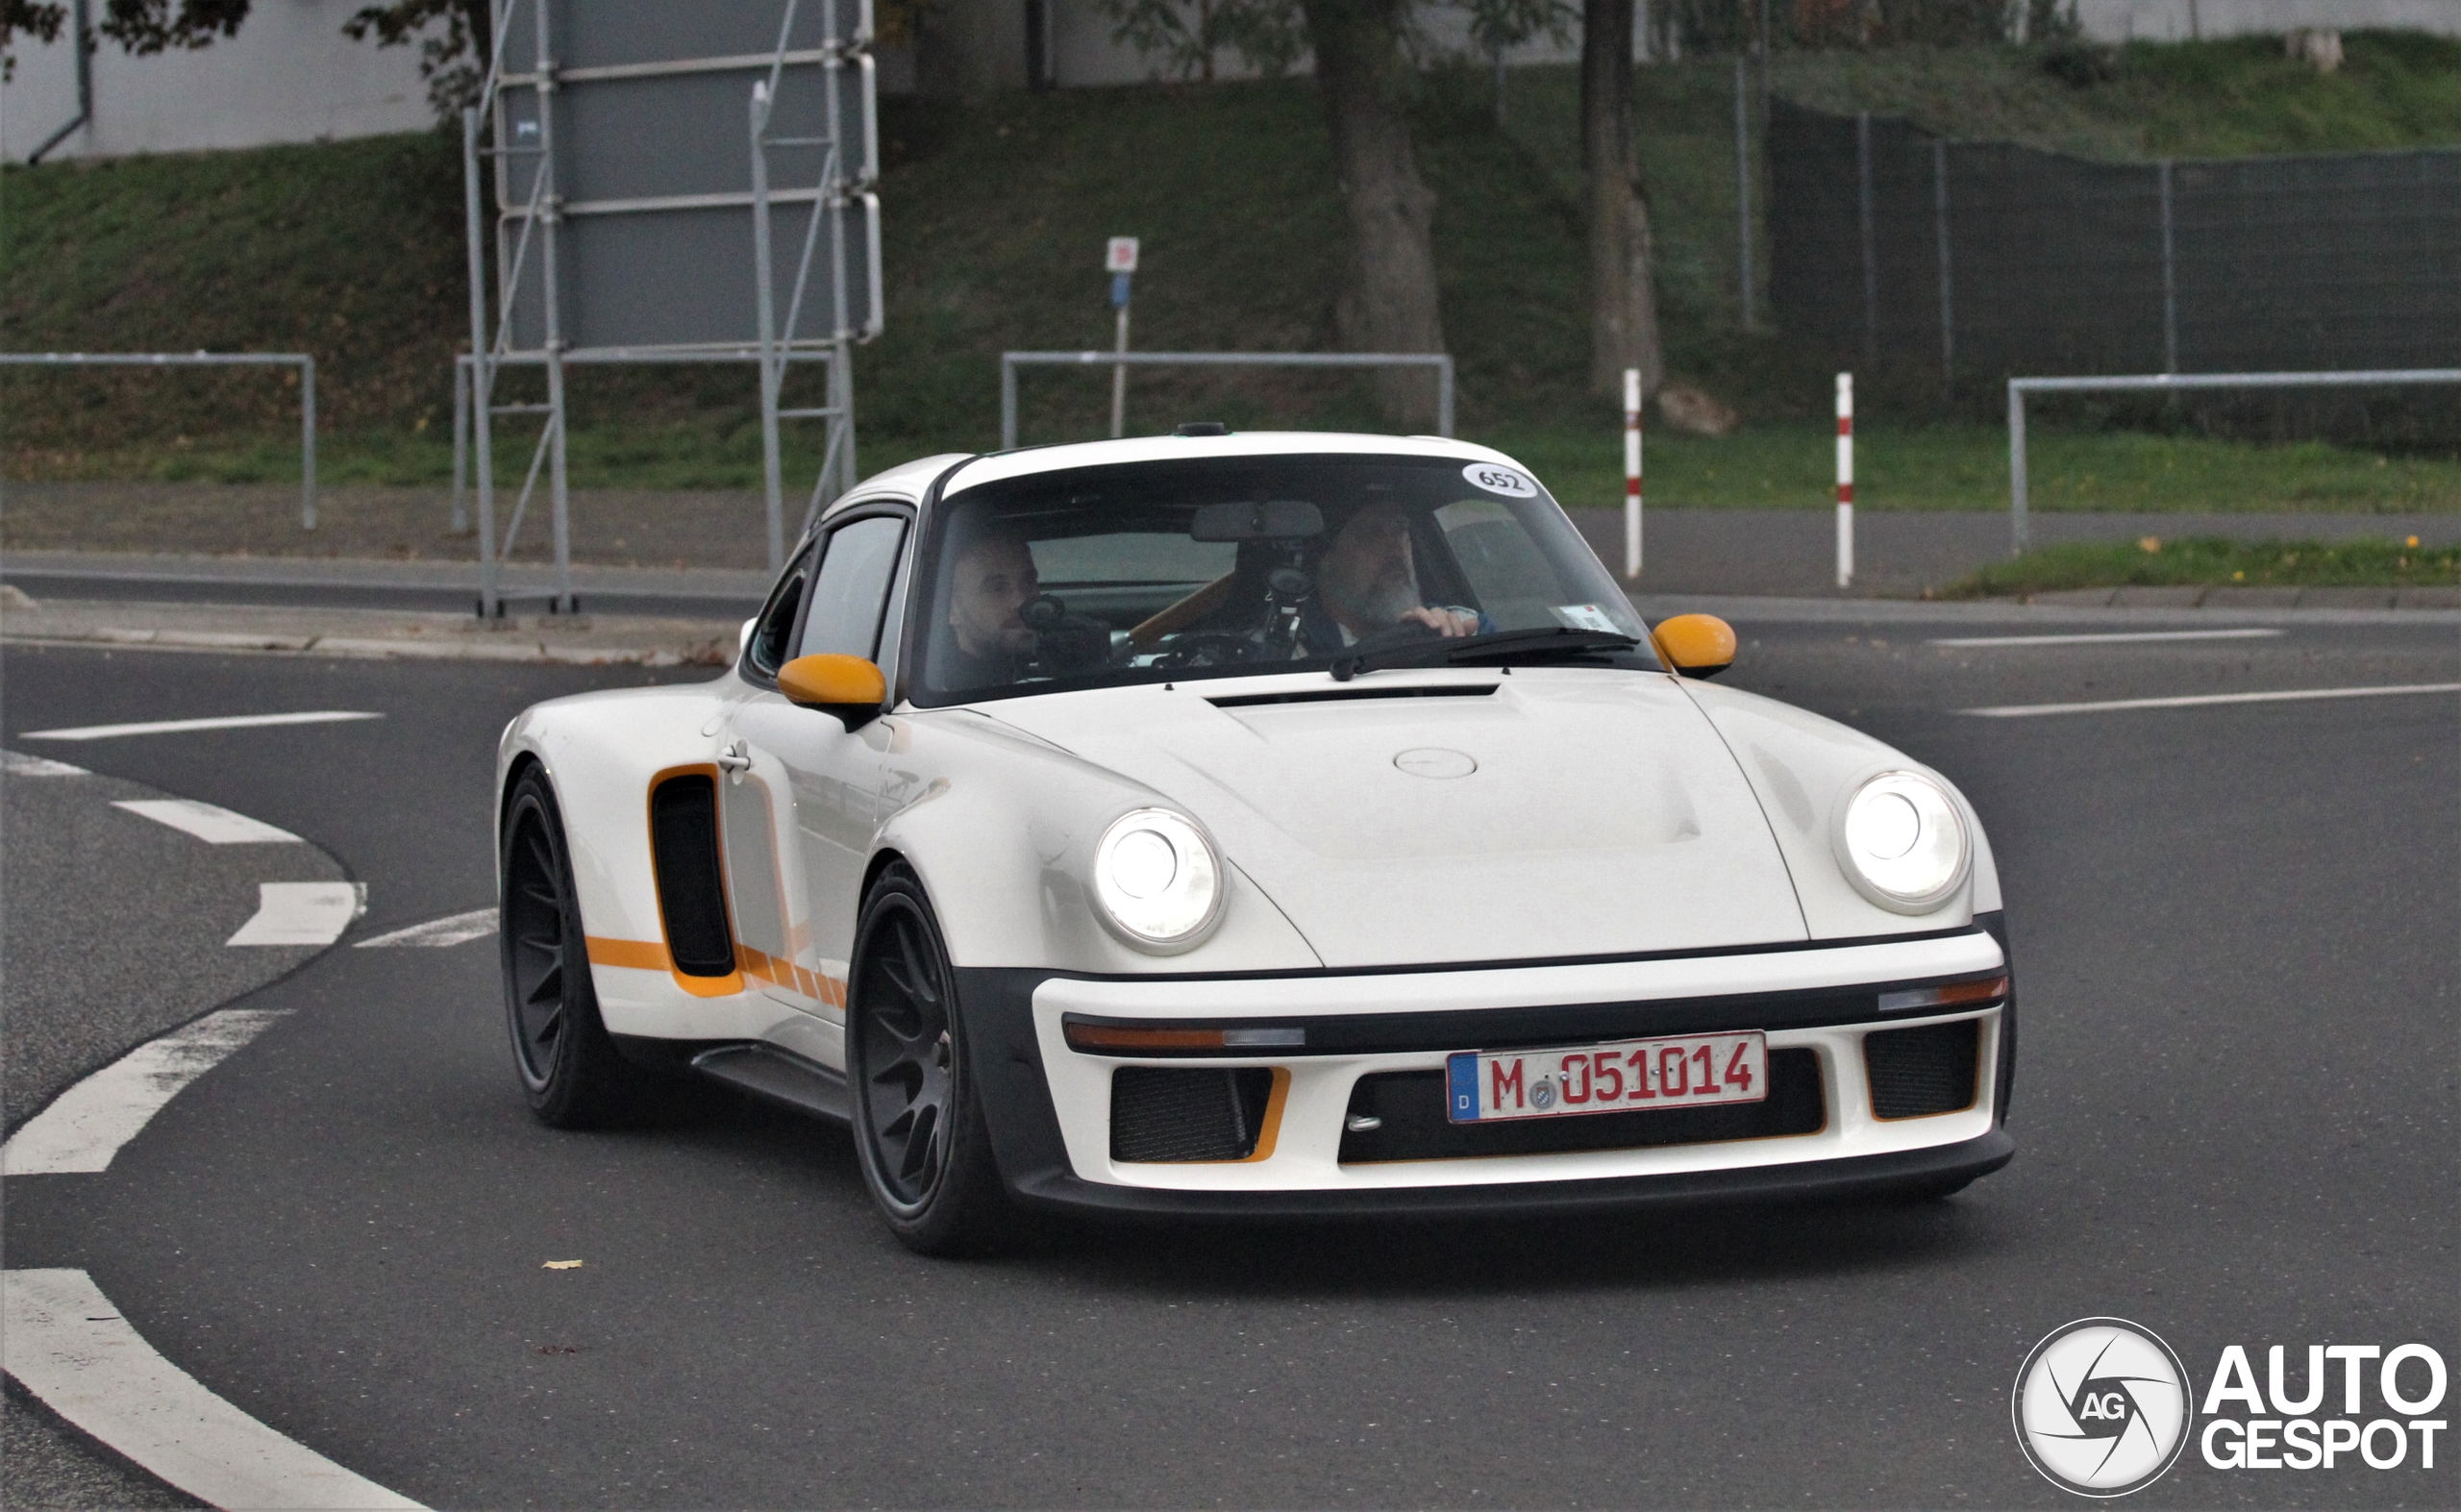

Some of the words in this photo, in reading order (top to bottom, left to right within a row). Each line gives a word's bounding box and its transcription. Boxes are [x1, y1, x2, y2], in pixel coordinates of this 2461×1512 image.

[1479, 471, 1526, 491] 652
[1491, 1058, 1524, 1109] M
[1561, 1042, 1753, 1104] 051014
[1458, 1095, 1470, 1109] D
